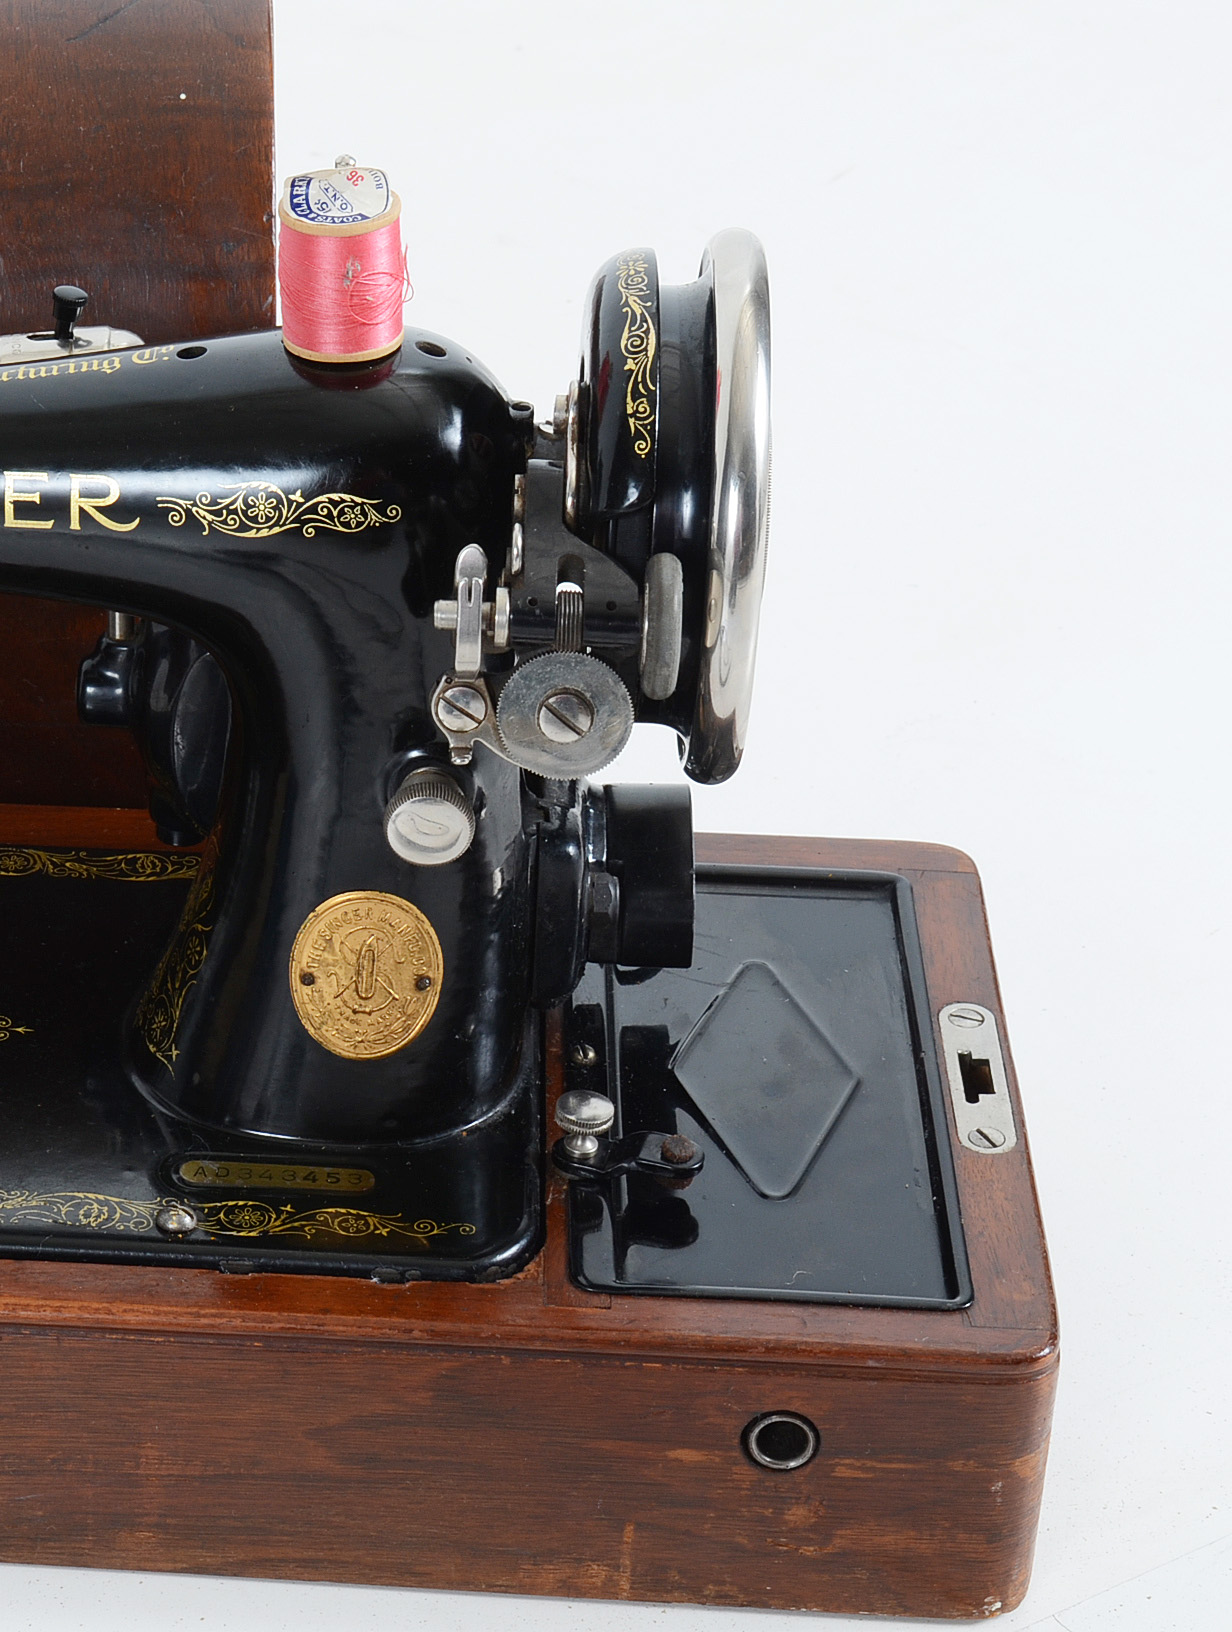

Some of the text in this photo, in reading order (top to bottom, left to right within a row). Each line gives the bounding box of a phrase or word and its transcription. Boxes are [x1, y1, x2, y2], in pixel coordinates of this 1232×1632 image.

[346, 170, 365, 187] 36
[314, 215, 362, 224] COATS
[319, 907, 374, 941] SINGER
